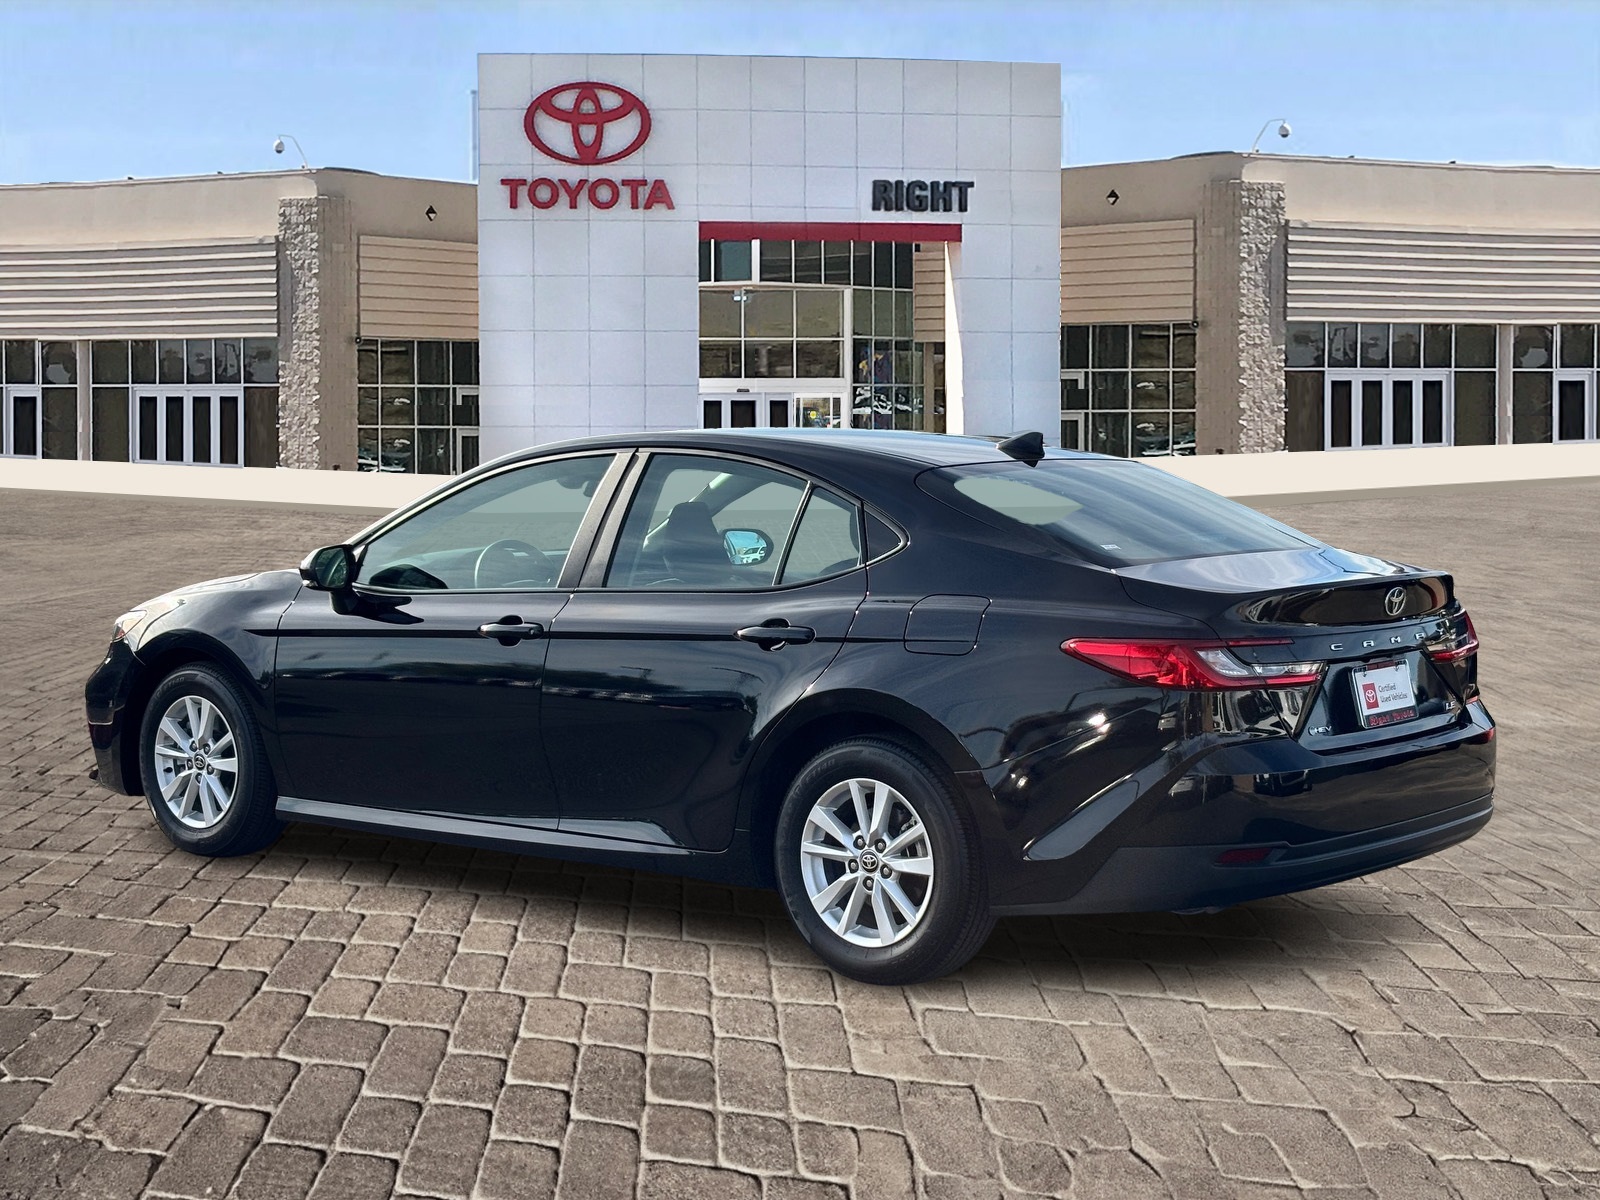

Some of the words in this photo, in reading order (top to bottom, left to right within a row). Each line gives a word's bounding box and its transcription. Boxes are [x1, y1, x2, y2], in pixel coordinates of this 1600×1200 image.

[500, 178, 675, 210] TOYOTA
[872, 180, 975, 212] RIGHT
[1378, 682, 1396, 693] Certified
[1379, 693, 1392, 703] Used
[1391, 690, 1408, 702] Vehicles
[1445, 701, 1456, 710] LE
[1314, 725, 1332, 734] HEV
